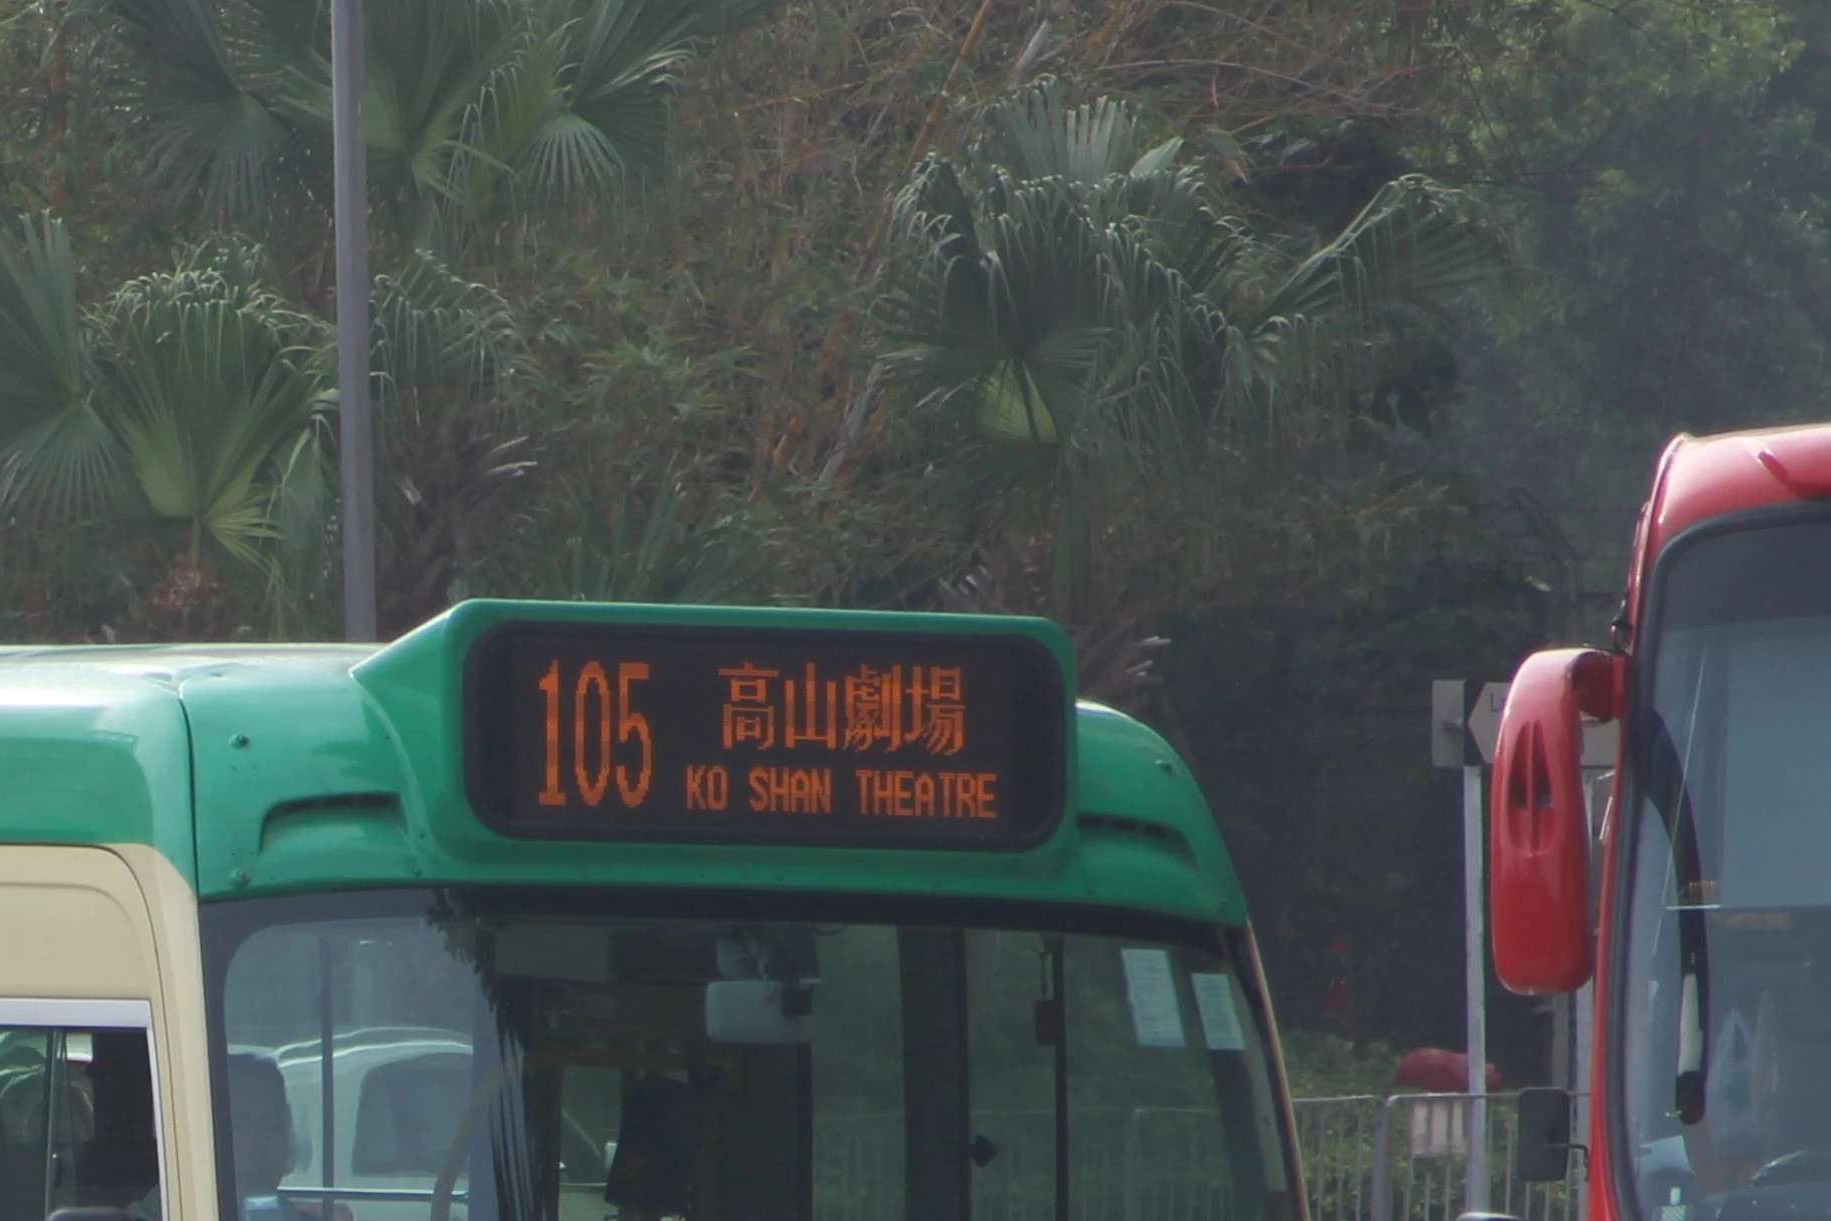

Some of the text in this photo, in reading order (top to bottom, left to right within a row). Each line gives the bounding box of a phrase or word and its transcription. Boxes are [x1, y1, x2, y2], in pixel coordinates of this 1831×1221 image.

[537, 659, 653, 808] 105
[717, 660, 966, 757] 高山劇場
[685, 763, 998, 820] KO SHAN THEATRE
